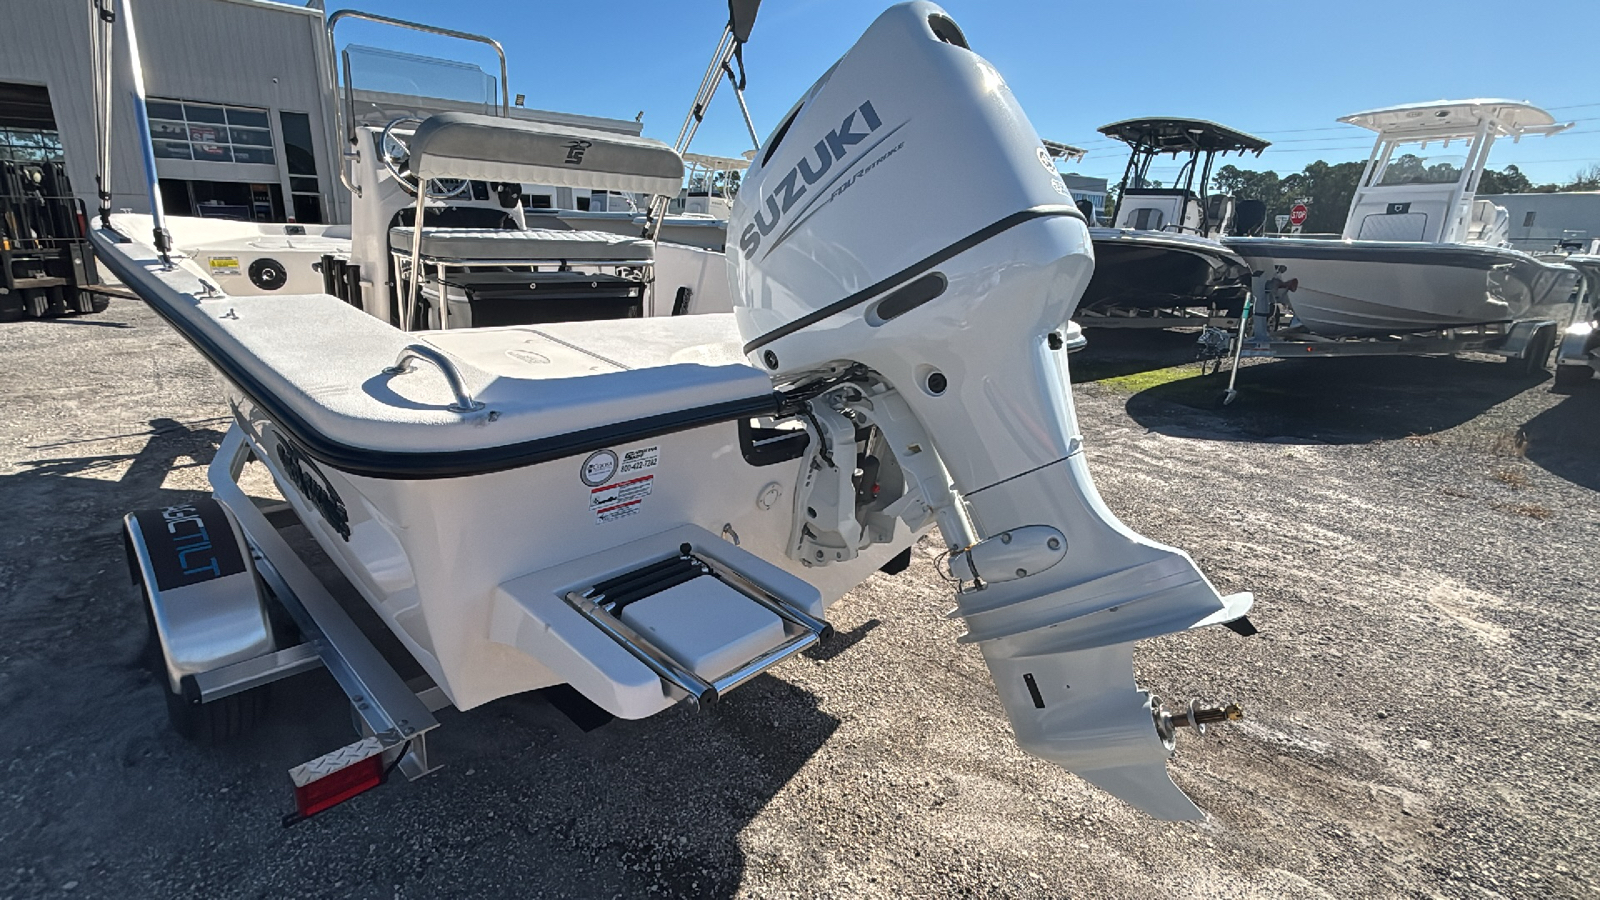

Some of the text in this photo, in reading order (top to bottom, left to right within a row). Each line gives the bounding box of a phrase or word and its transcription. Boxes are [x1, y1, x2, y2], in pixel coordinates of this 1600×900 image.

[740, 100, 882, 260] SUZUKI
[829, 141, 905, 203] FOUR STROKE
[1291, 211, 1306, 219] STOP
